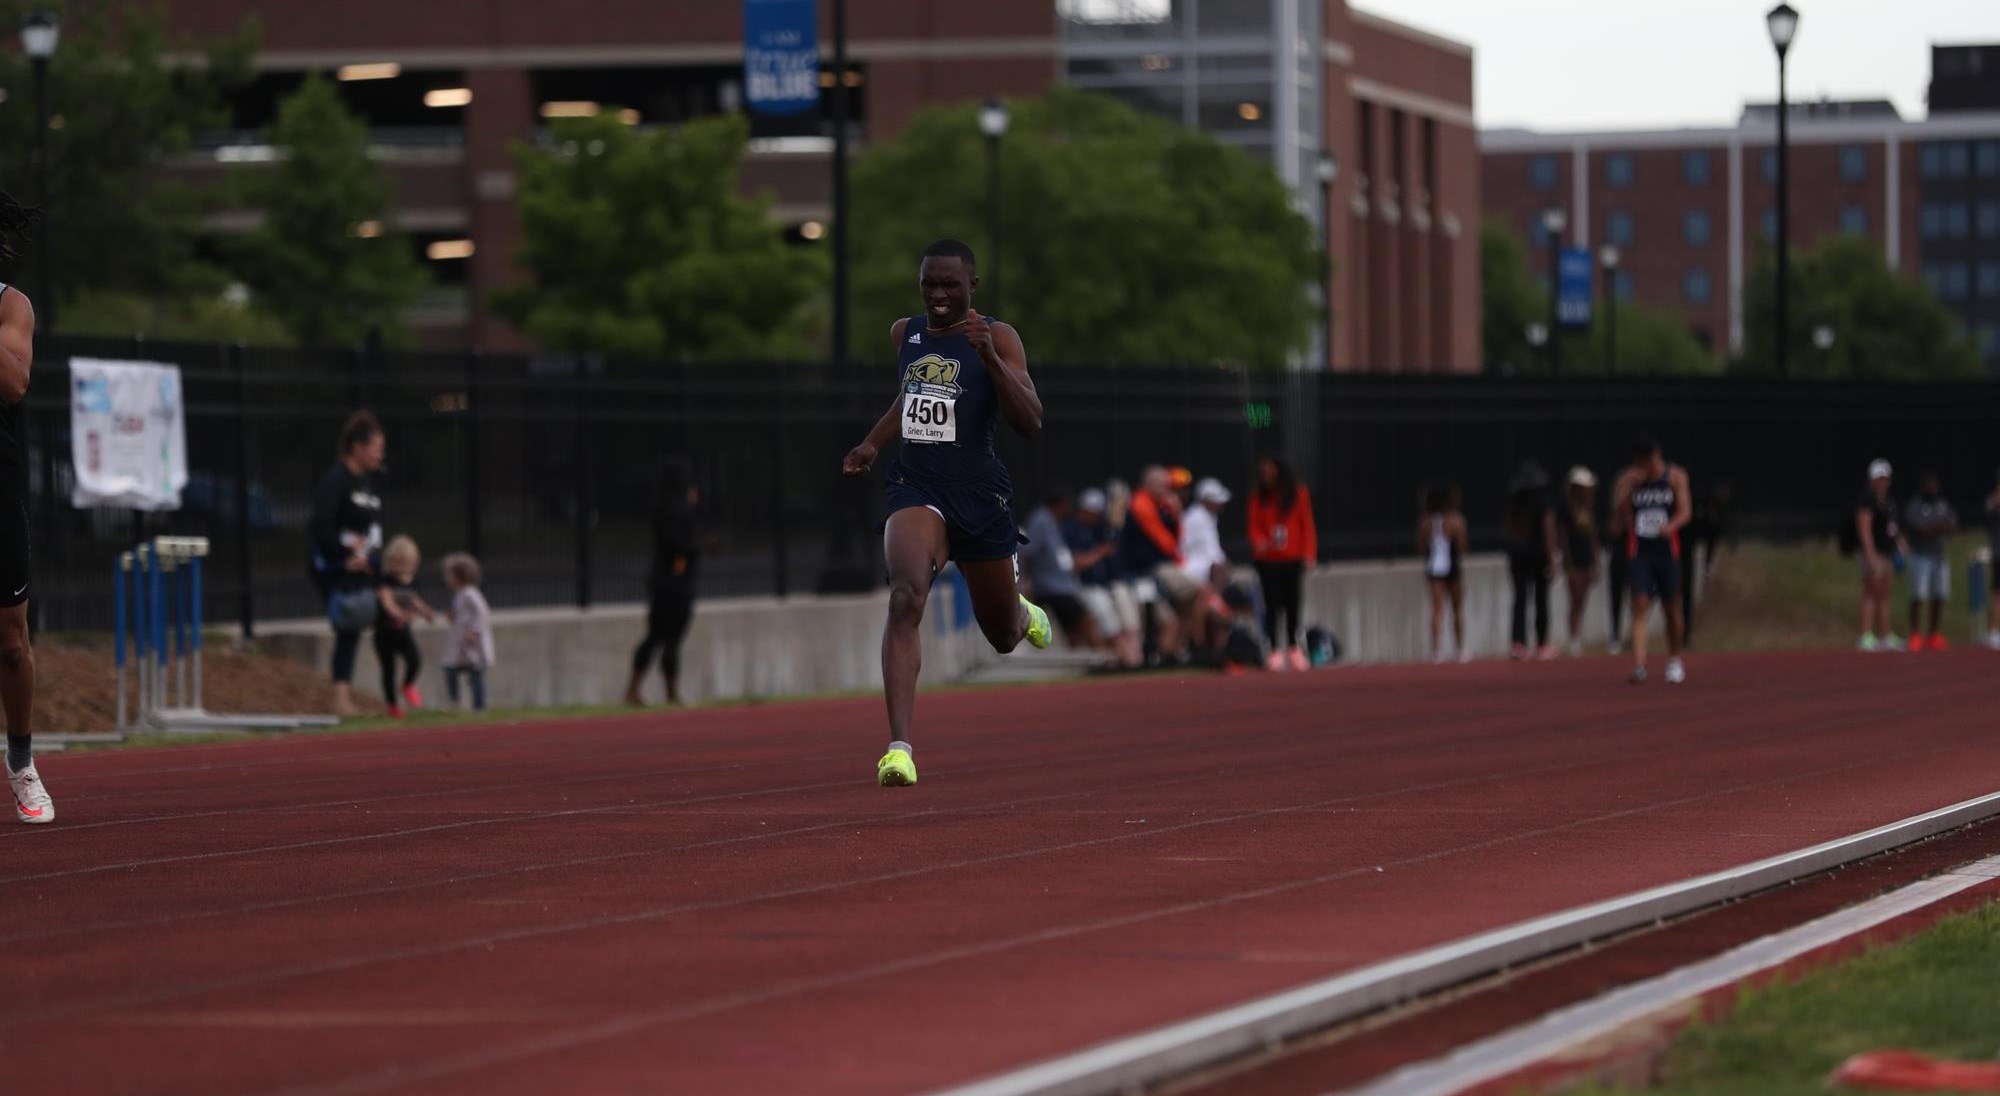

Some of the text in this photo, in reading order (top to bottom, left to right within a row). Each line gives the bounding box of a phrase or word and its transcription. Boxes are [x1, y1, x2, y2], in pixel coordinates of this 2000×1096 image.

[906, 397, 948, 426] 450
[907, 426, 944, 439] Grier, Larry
